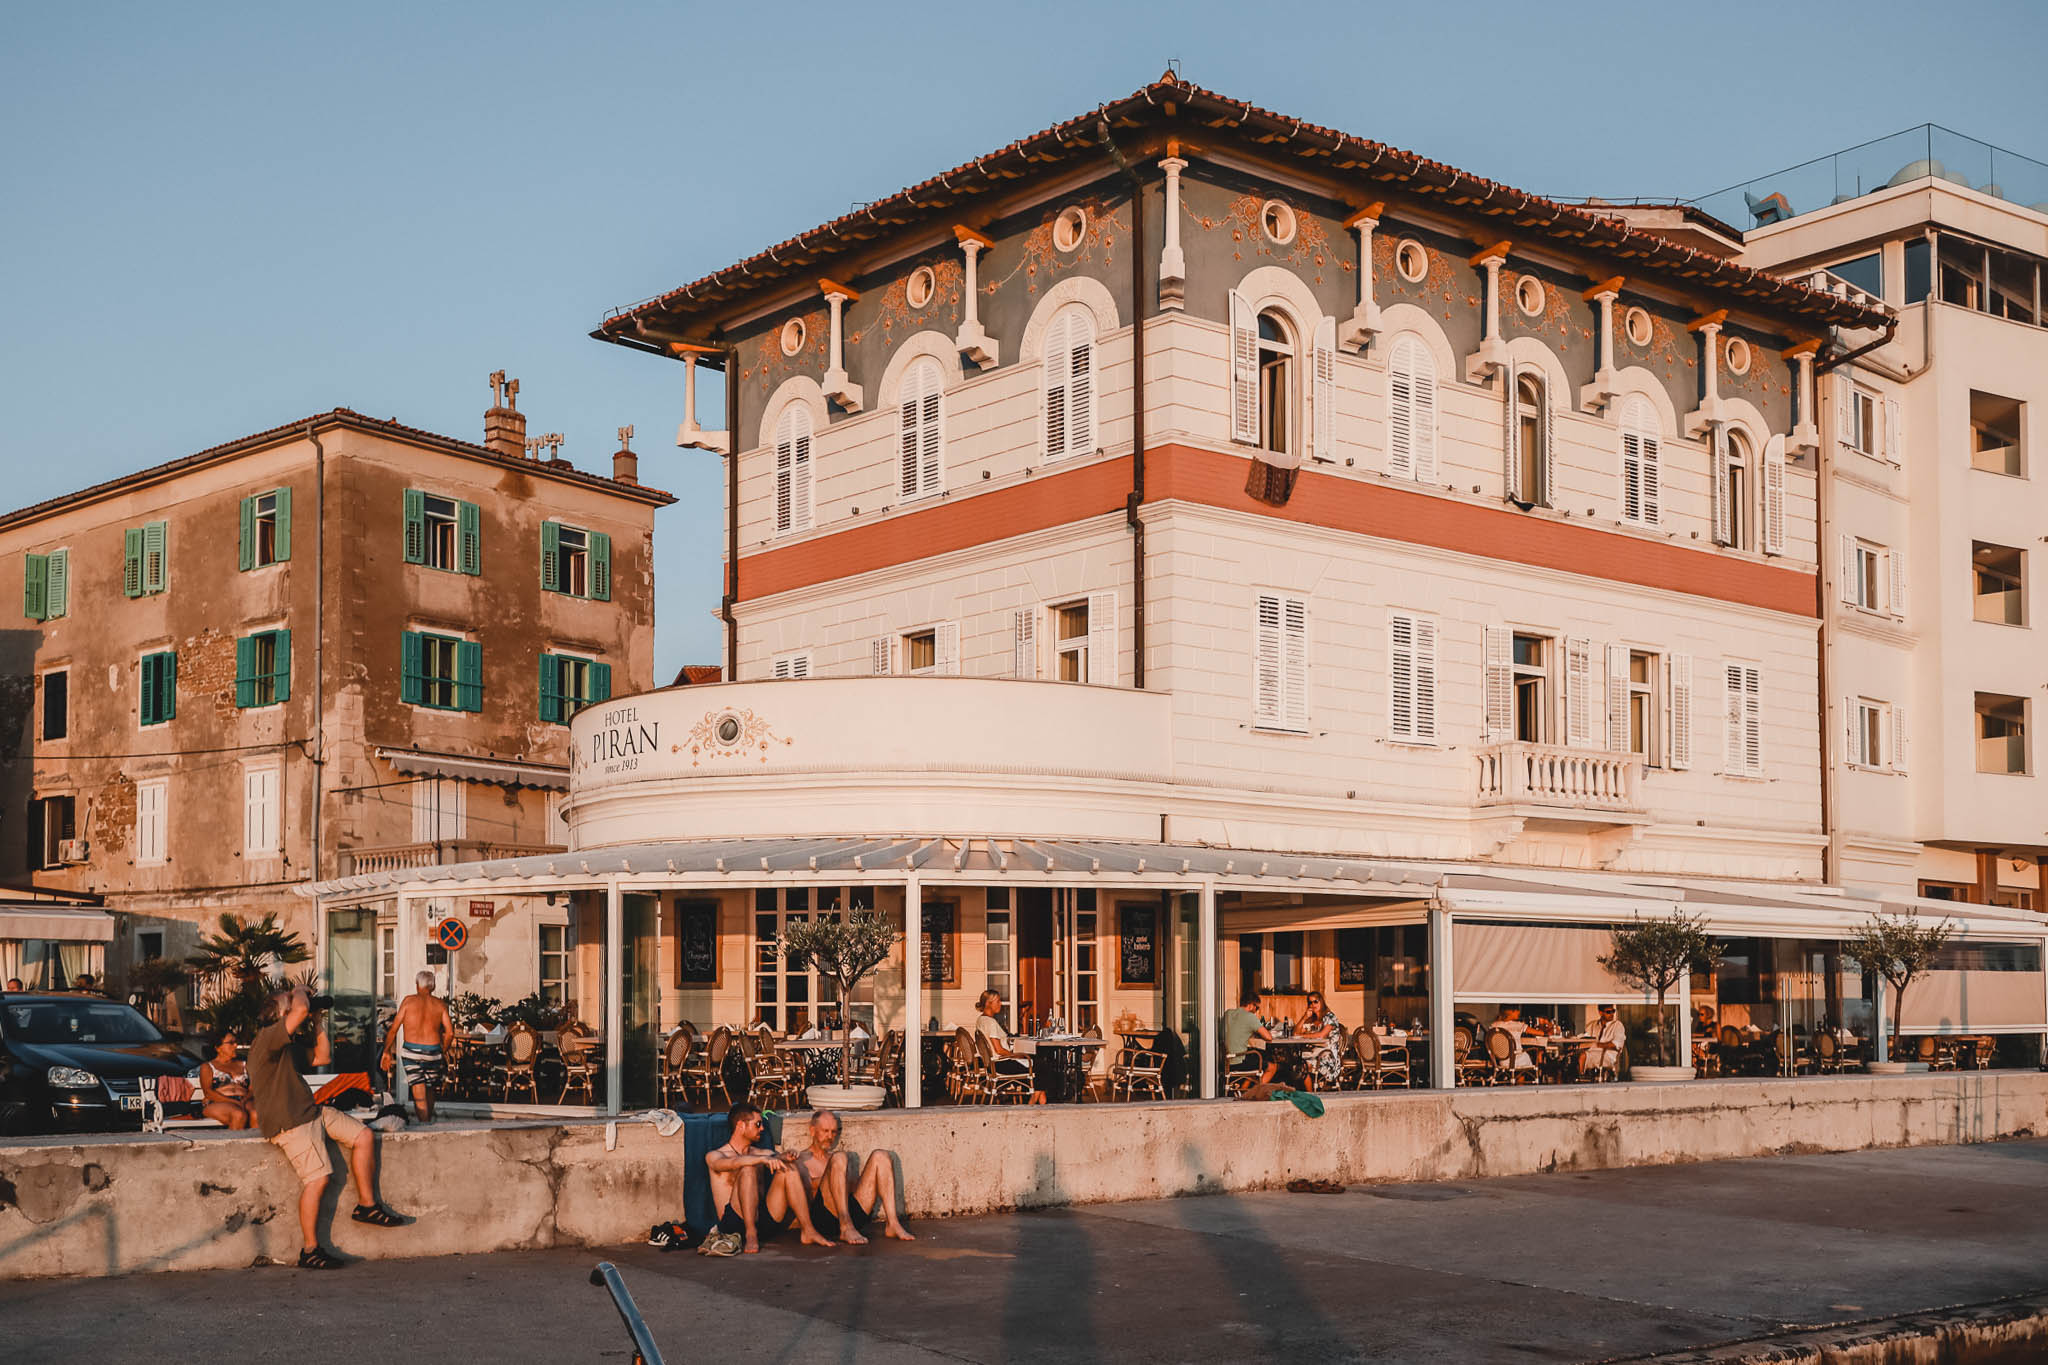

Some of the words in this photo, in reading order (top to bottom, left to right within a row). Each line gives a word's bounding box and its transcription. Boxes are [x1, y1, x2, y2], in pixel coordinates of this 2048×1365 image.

[605, 707, 639, 727] HOTEL
[593, 722, 659, 763] PIRAN
[605, 762, 620, 774] since
[621, 758, 638, 771] 1913
[130, 1098, 141, 1108] KR
